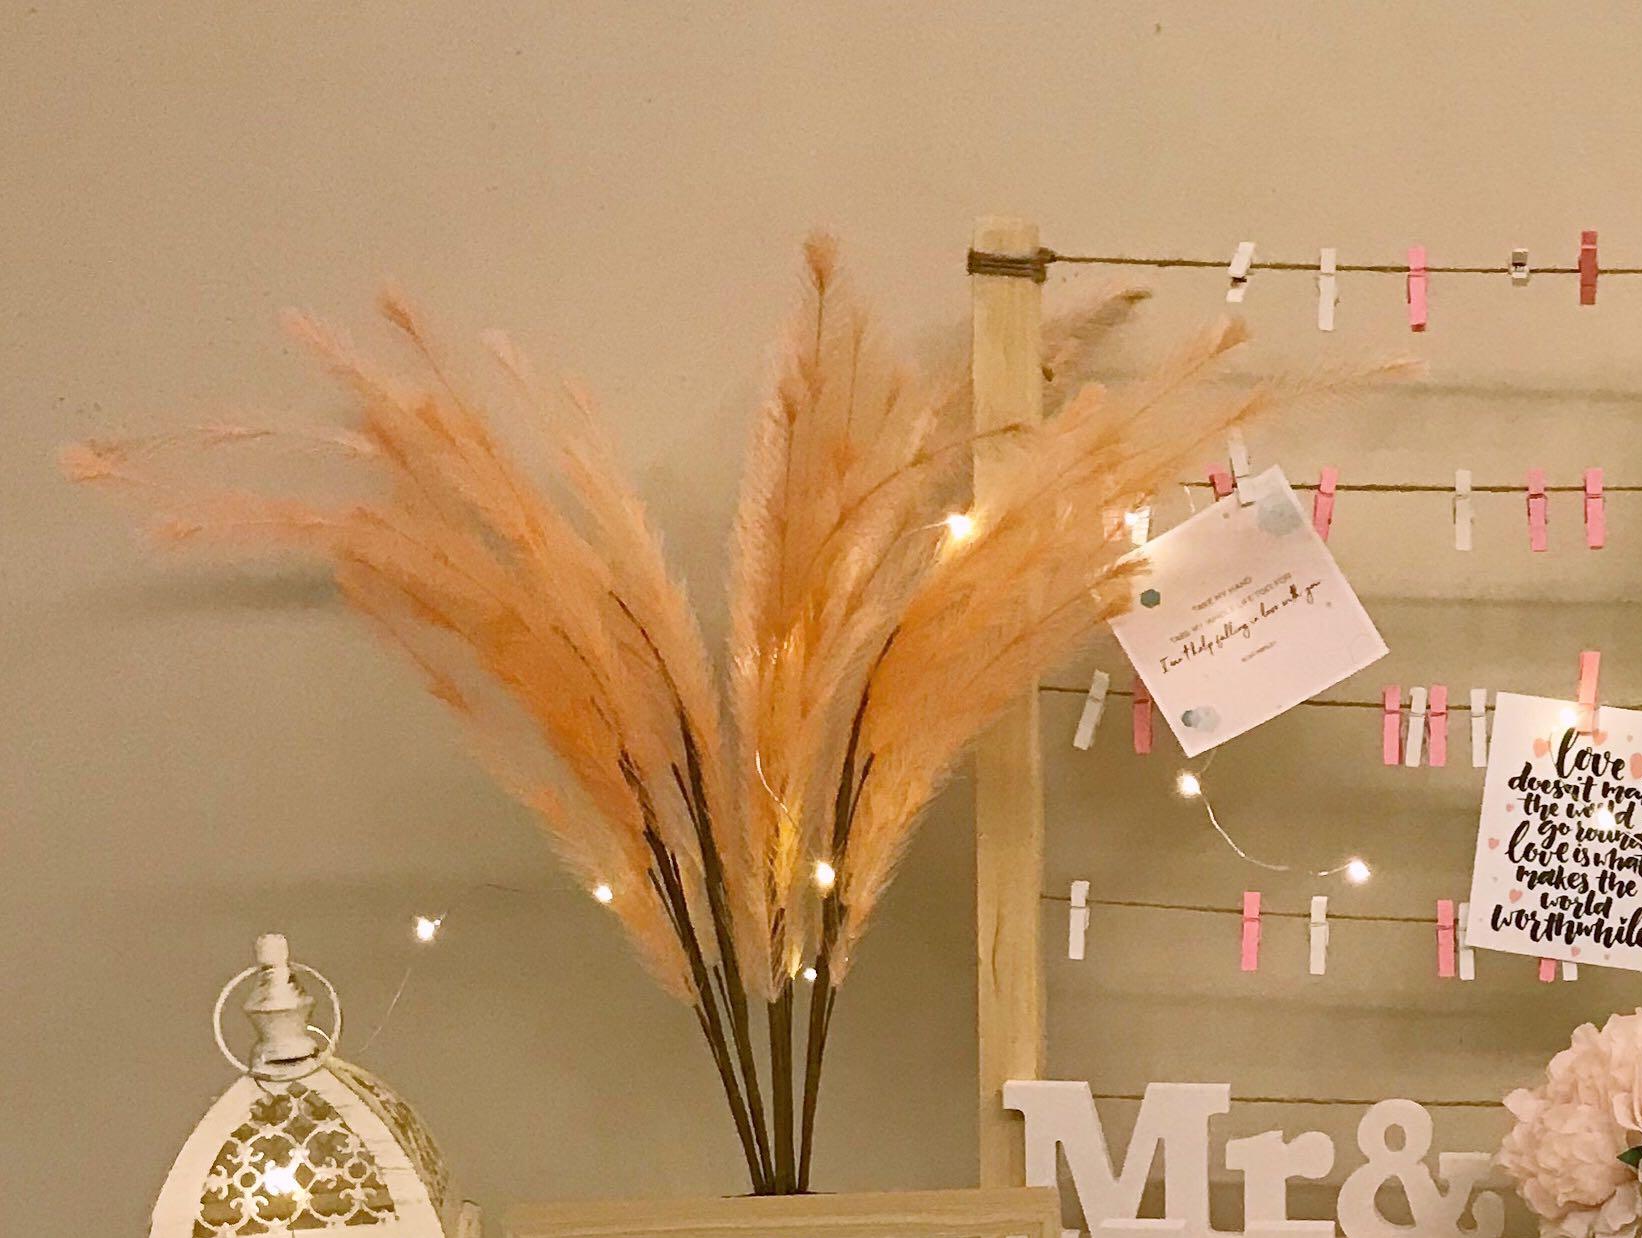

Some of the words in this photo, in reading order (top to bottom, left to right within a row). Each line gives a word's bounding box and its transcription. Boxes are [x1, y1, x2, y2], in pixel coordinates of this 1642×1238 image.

[1556, 727, 1625, 781] love
[1517, 793, 1560, 818] the
[1505, 820, 1570, 864] love
[1572, 842, 1592, 868] is
[1537, 820, 1571, 851] go
[1515, 864, 1591, 893] makes
[1595, 868, 1639, 899] the
[1539, 889, 1615, 920] world
